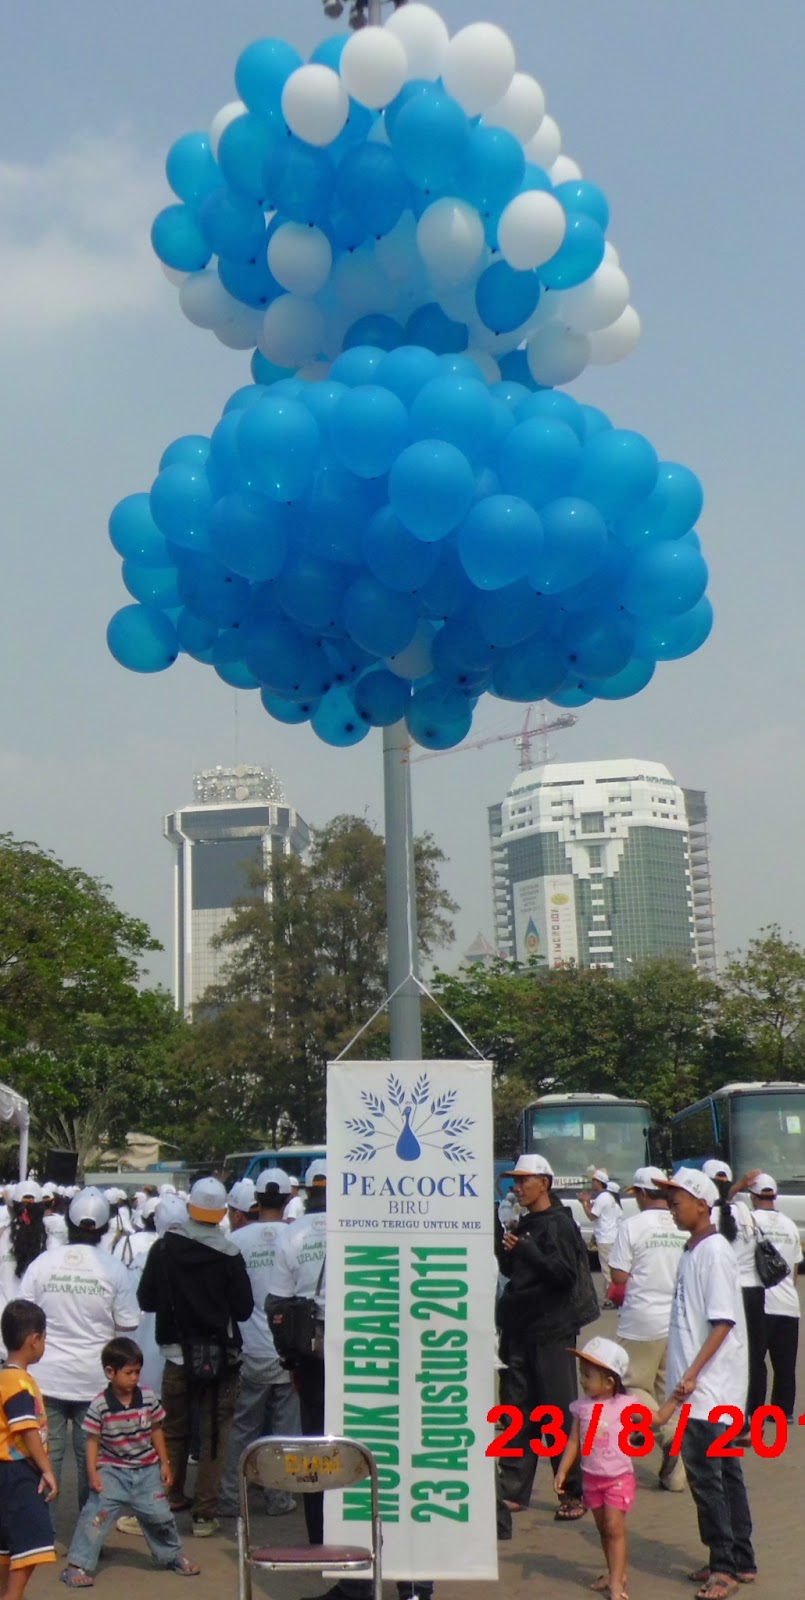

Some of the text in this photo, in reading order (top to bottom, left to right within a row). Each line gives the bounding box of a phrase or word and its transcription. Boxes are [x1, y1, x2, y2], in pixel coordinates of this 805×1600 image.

[341, 1172, 478, 1197] PEACOCK
[388, 1200, 429, 1215] BIRU
[339, 1219, 481, 1230] TEPUNG TERIGU UNTUK MIE
[343, 1245, 400, 1396] LEBARAN
[409, 1246, 476, 1524] 23 Agustus 2011
